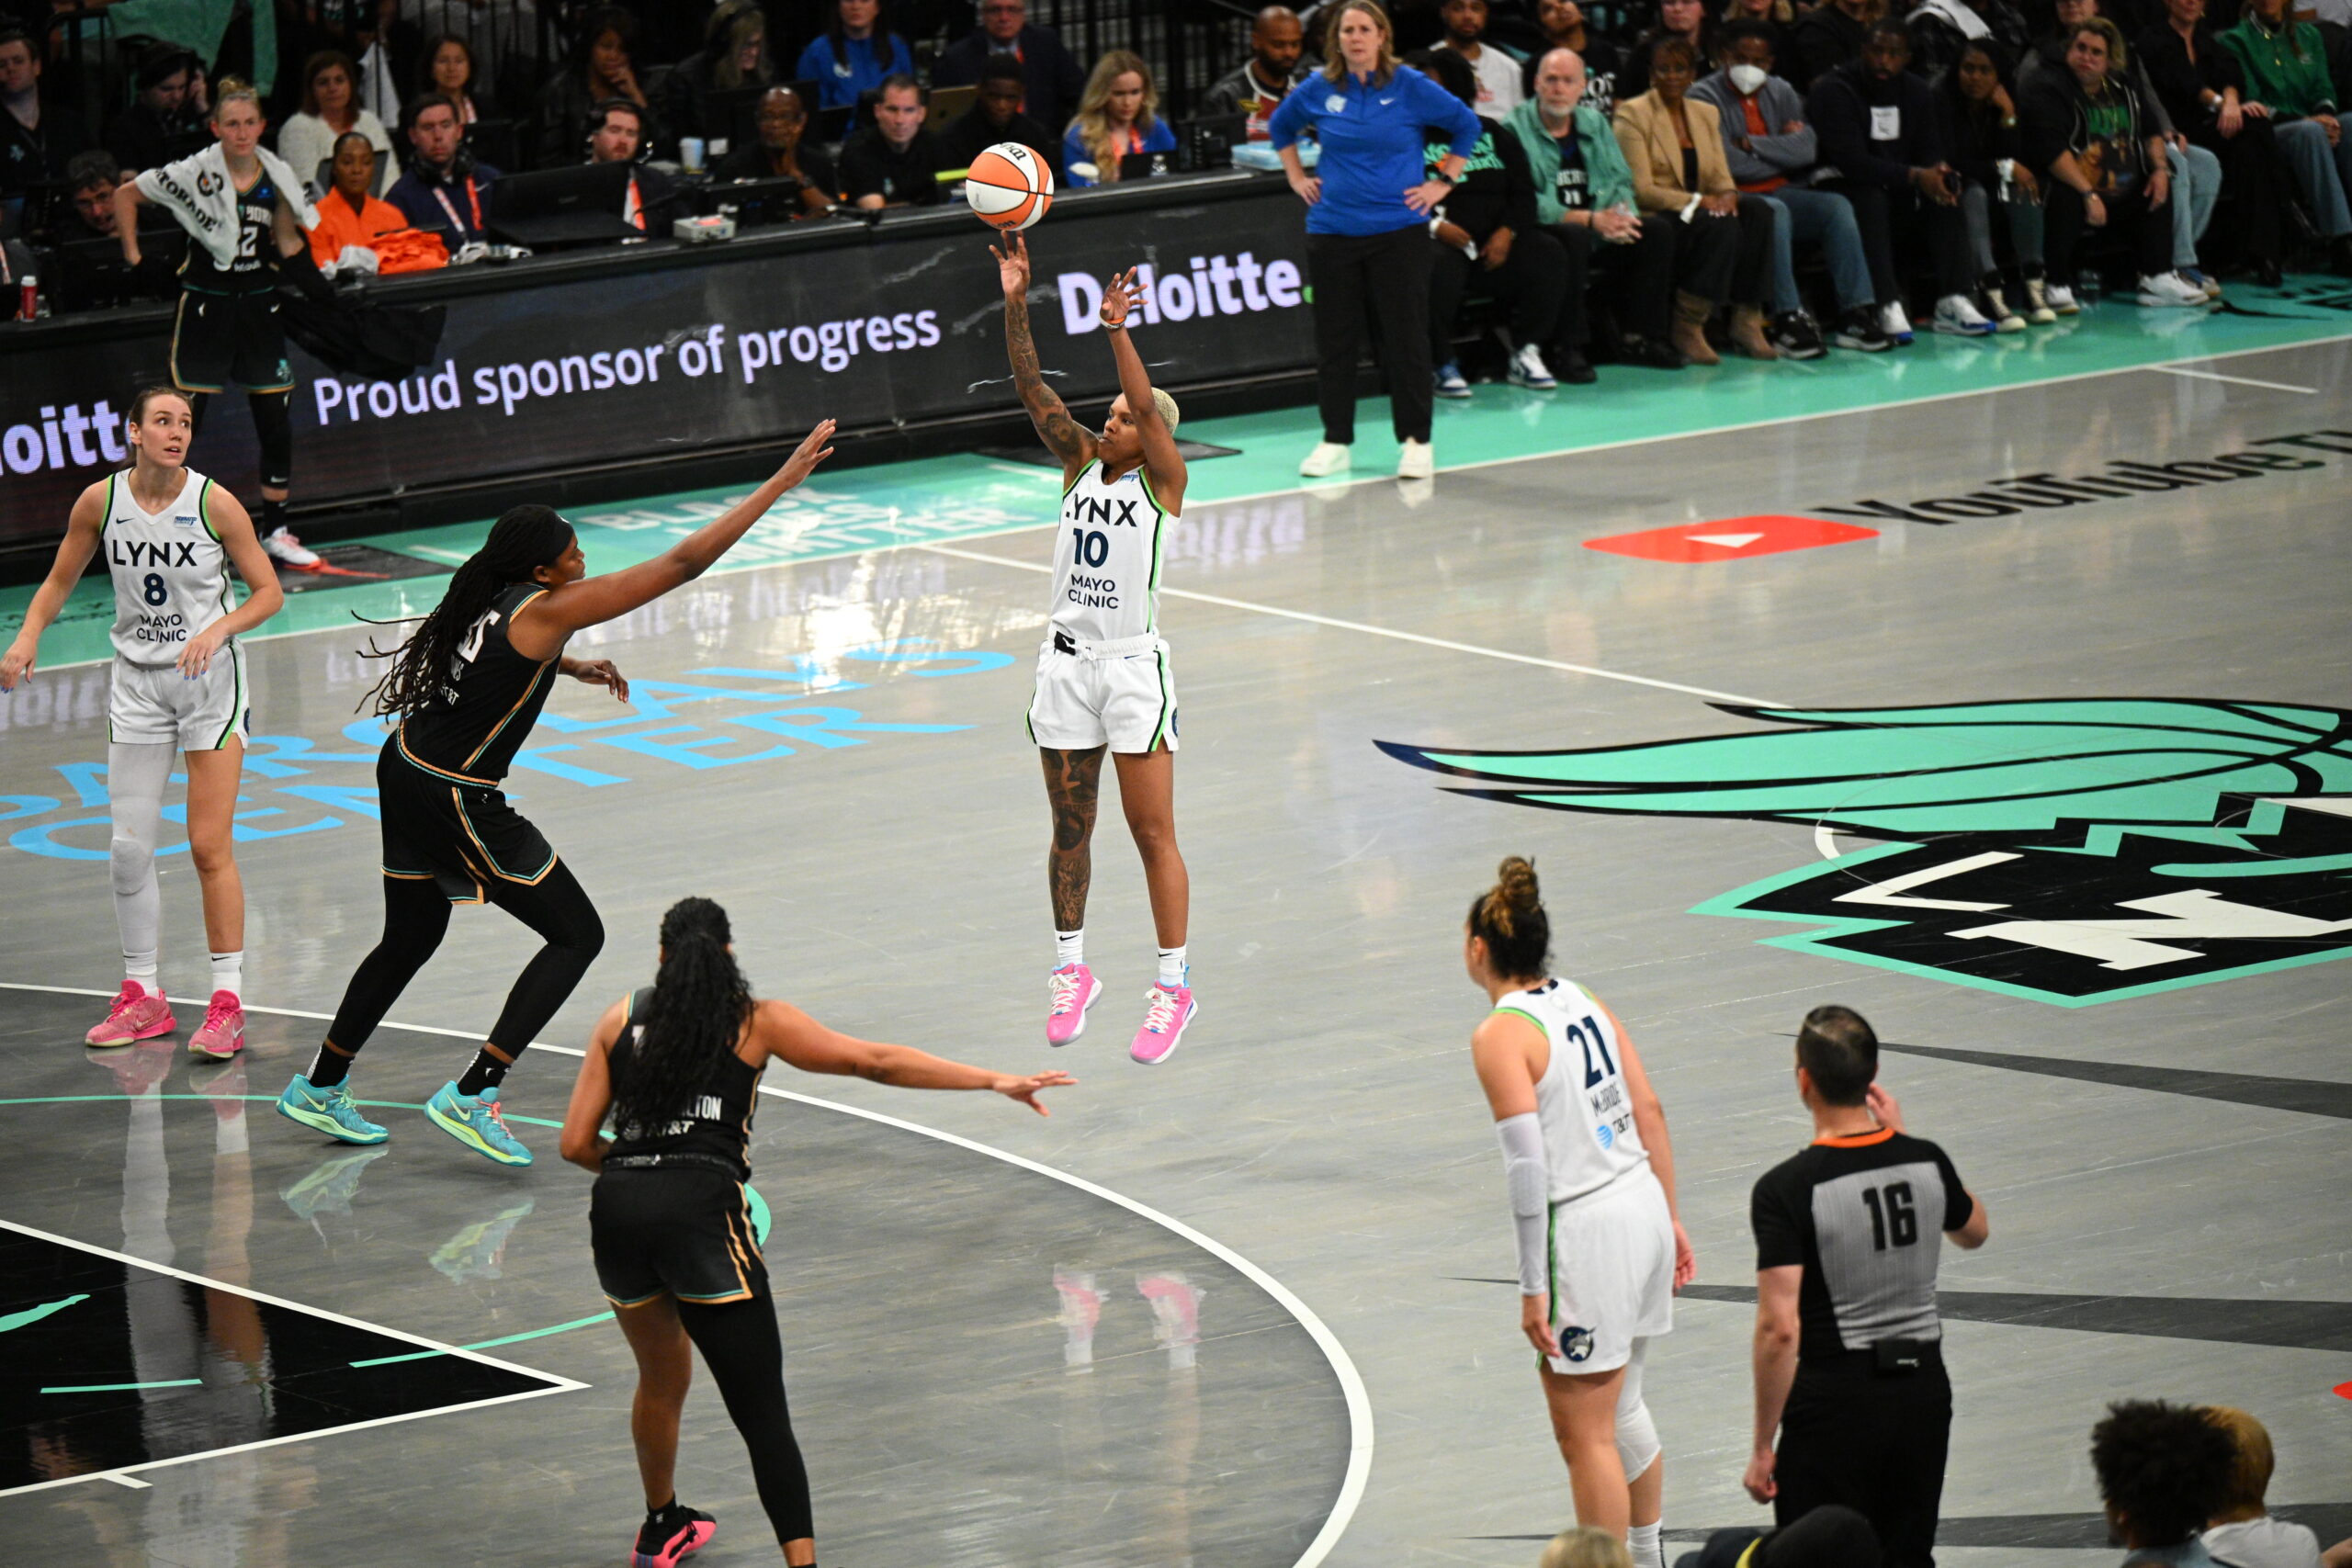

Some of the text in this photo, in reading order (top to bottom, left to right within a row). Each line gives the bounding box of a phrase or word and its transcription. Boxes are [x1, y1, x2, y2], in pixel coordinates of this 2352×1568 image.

[313, 309, 941, 425] Proud sponsor of progress
[1808, 453, 2325, 526] YouTube
[1066, 493, 1138, 527] YNX
[112, 539, 198, 568] LYNX
[1073, 527, 1109, 568] 10
[143, 573, 167, 606] 8
[1068, 589, 1119, 610] CLINIC
[1070, 574, 1115, 592] MAYO
[137, 627, 187, 642] CLINIC
[140, 614, 182, 628] MAYO
[1566, 1015, 1615, 1089] 21
[1861, 1180, 1917, 1251] 16
